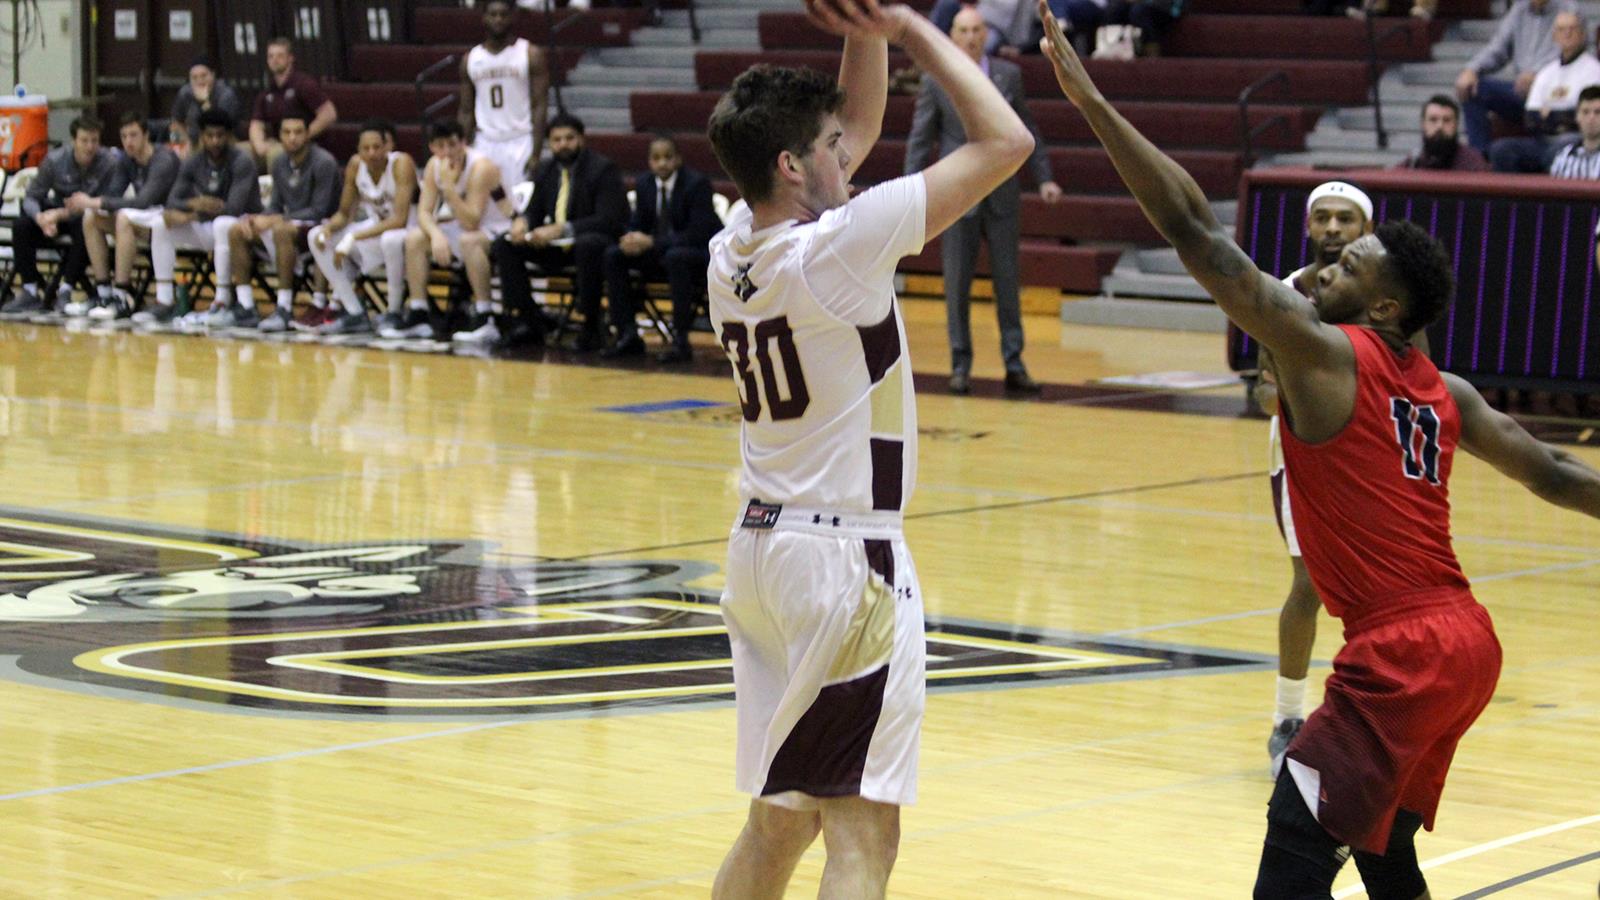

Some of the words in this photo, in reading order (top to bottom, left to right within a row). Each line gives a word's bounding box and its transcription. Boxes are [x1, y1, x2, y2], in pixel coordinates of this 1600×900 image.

[491, 84, 503, 108] 0
[721, 315, 810, 422] 30
[1389, 396, 1442, 486] 11
